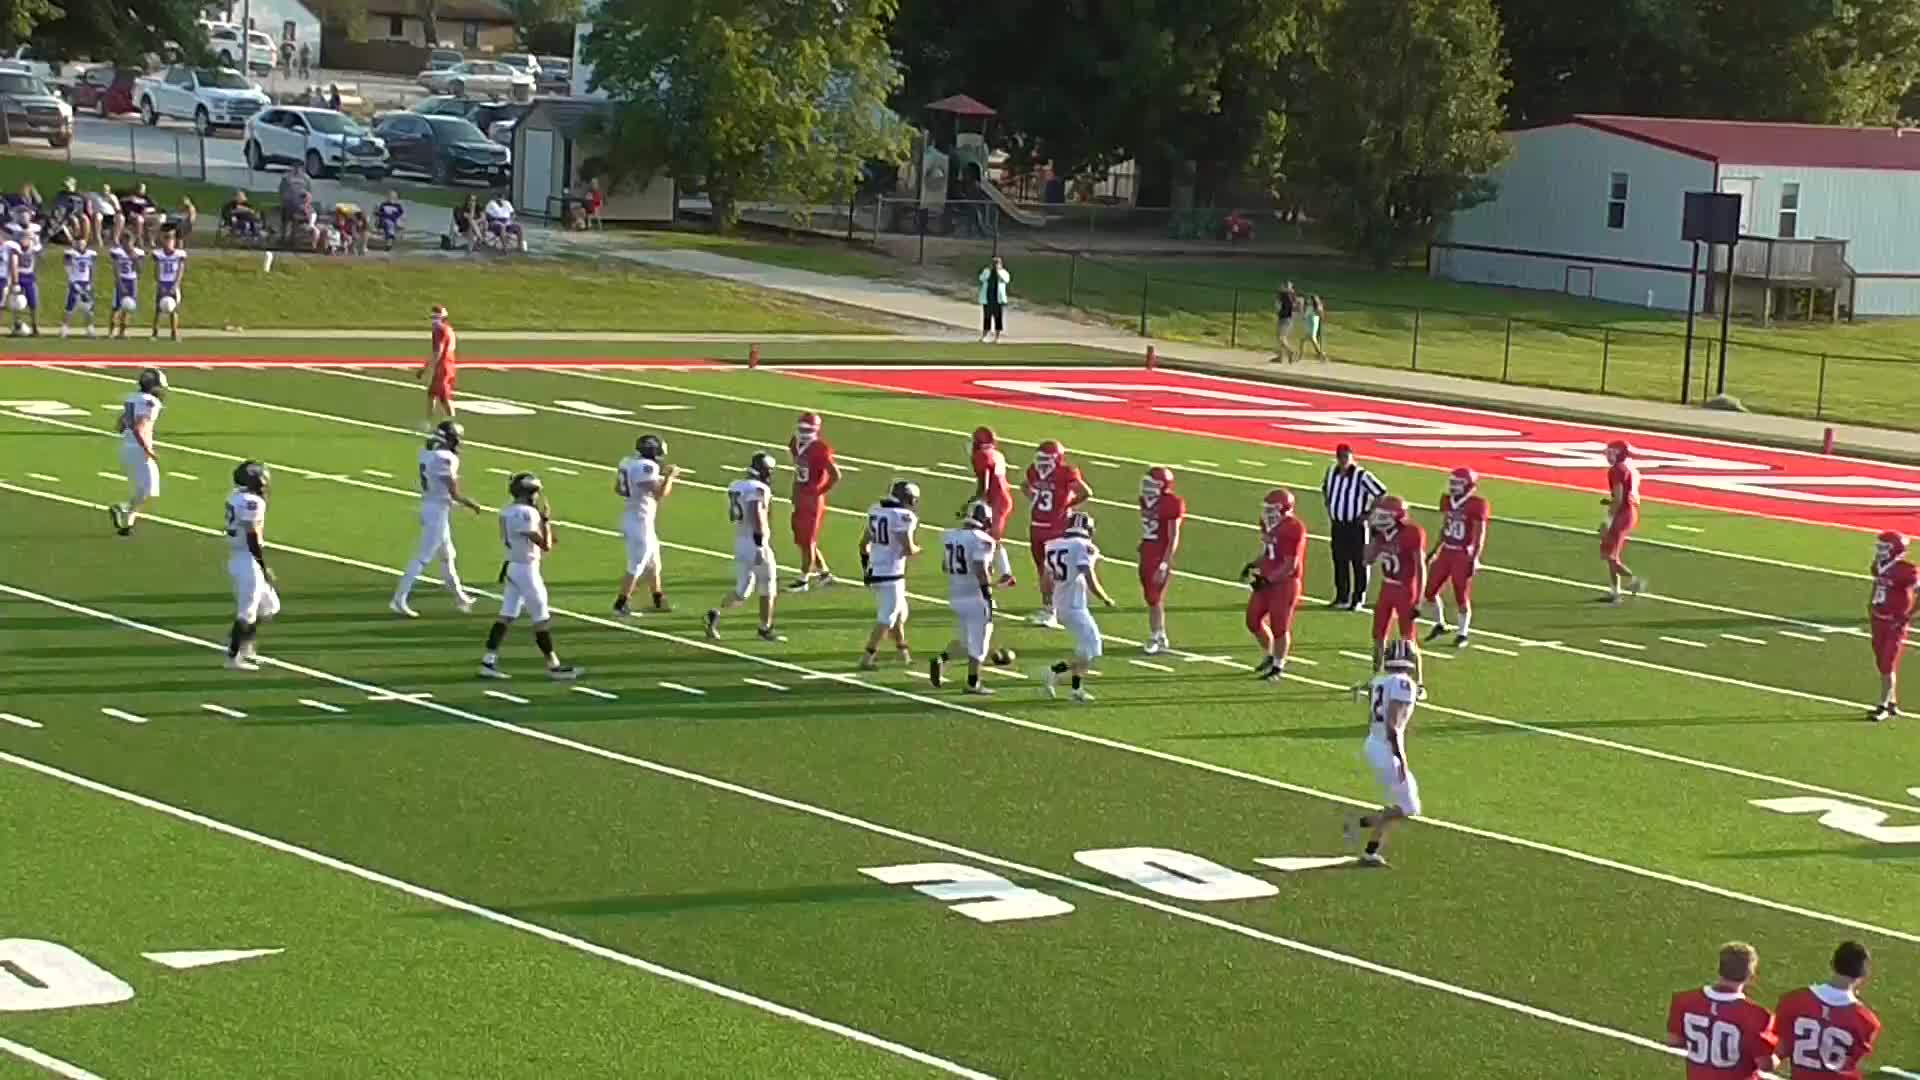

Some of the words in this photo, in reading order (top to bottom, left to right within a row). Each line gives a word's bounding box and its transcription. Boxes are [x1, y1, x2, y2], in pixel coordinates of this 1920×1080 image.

[1031, 489, 1054, 512] 73
[943, 543, 968, 575] 79
[1047, 548, 1069, 582] 55
[1747, 787, 1920, 843] 2
[1683, 1012, 1741, 1068] 50
[1792, 1016, 1854, 1073] 26
